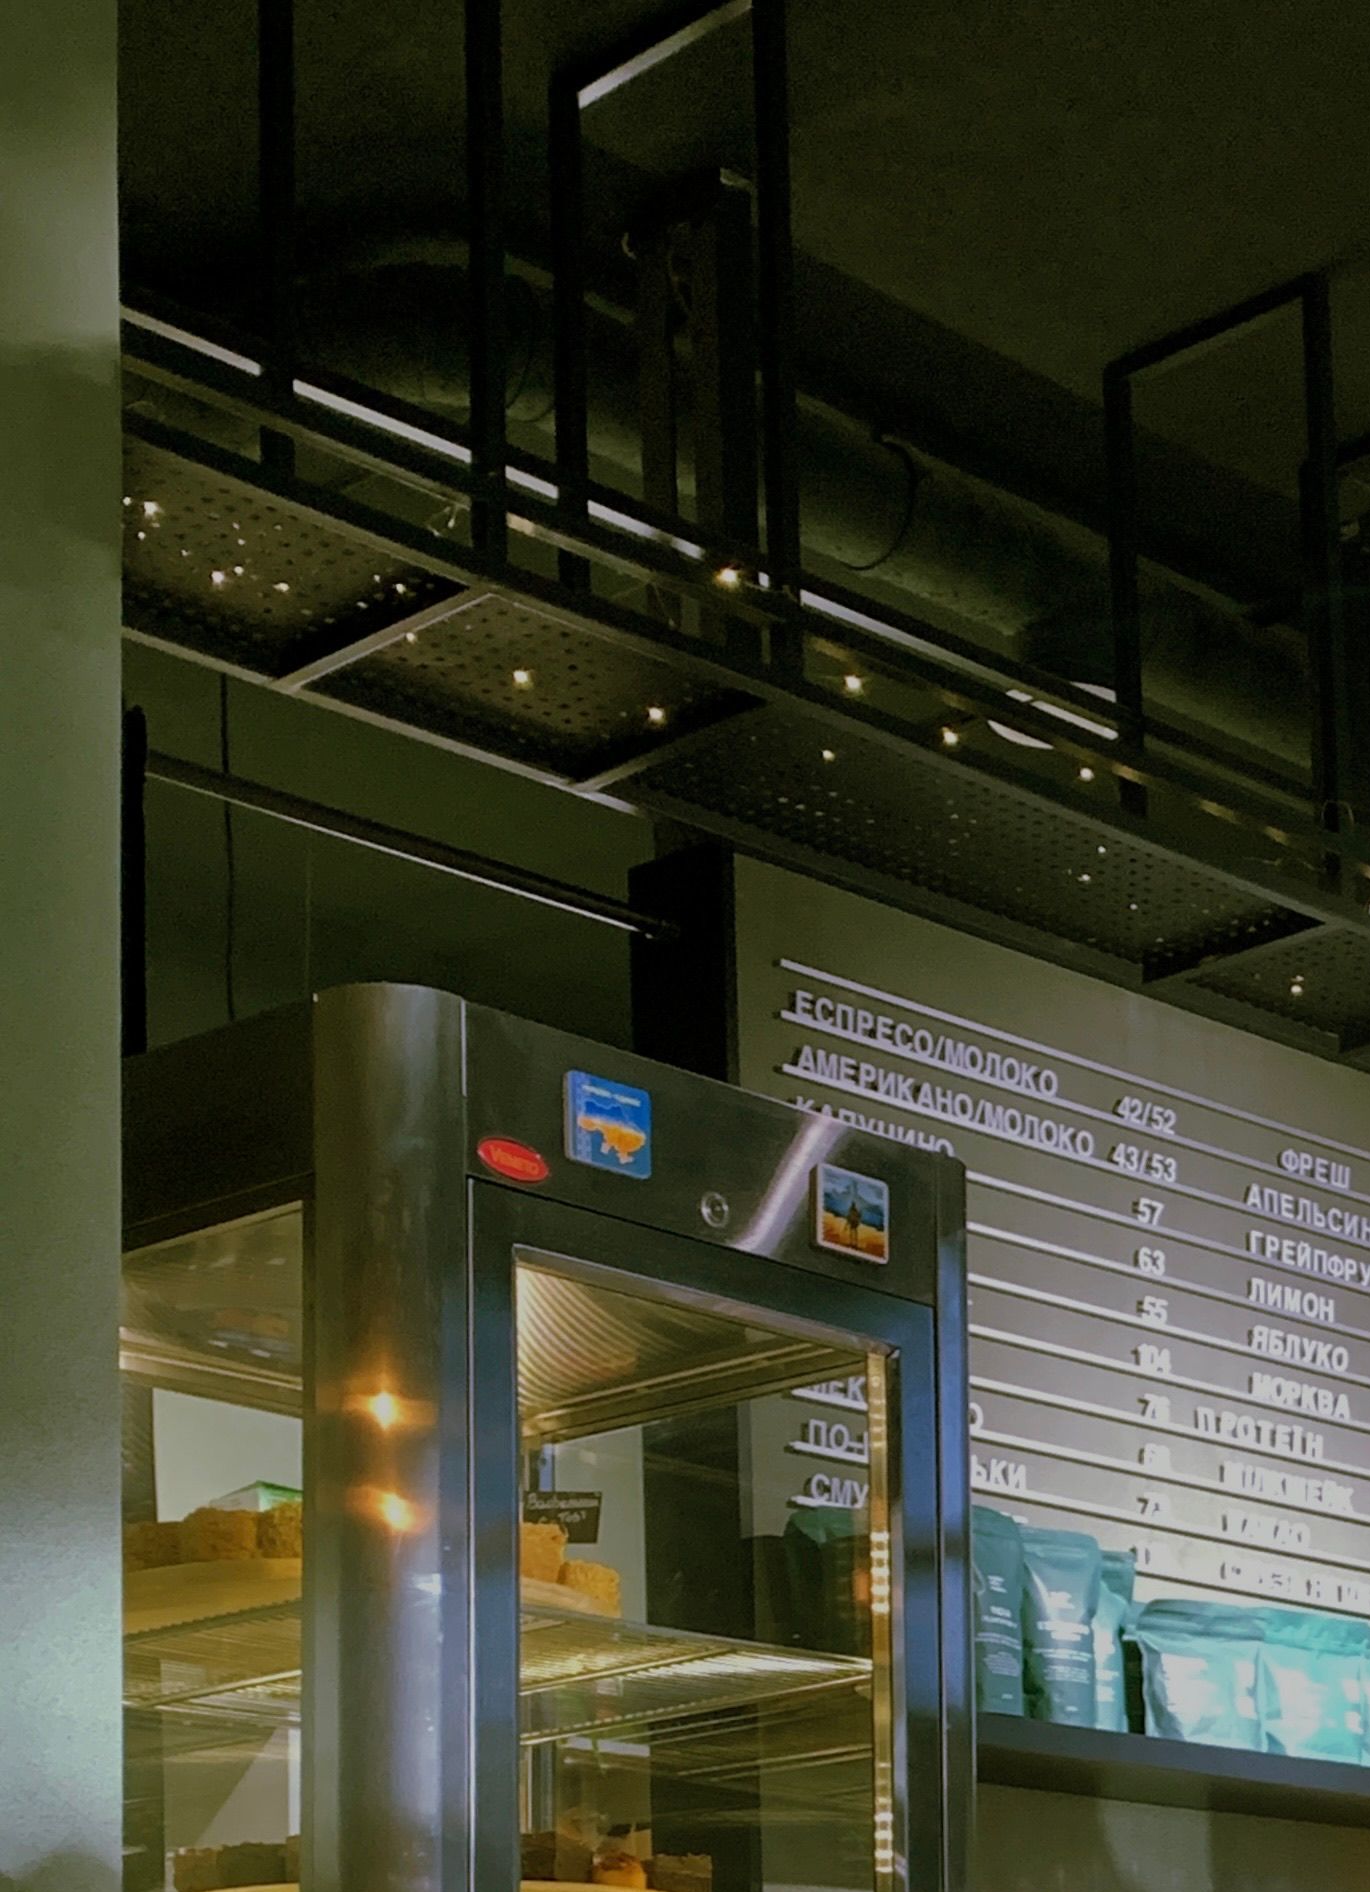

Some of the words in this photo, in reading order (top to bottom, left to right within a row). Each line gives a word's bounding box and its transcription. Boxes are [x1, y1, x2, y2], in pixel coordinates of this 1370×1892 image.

[796, 990, 1058, 1098] ЕСПРЕСО/МОЛОКО
[799, 1045, 1094, 1157] АМЕРИКАНО/МОЛОКО
[1117, 1096, 1176, 1135] 42/52
[1112, 1143, 1177, 1182] 43/53
[1281, 1149, 1350, 1190] ФРЕШ
[1137, 1198, 1164, 1226] 57
[1138, 1247, 1165, 1276] 63
[1141, 1296, 1168, 1325] 55
[1249, 1278, 1335, 1323] ЛИМОН
[1250, 1326, 1349, 1373] ЯБЛУКО
[1251, 1372, 1351, 1421] МОРКВА
